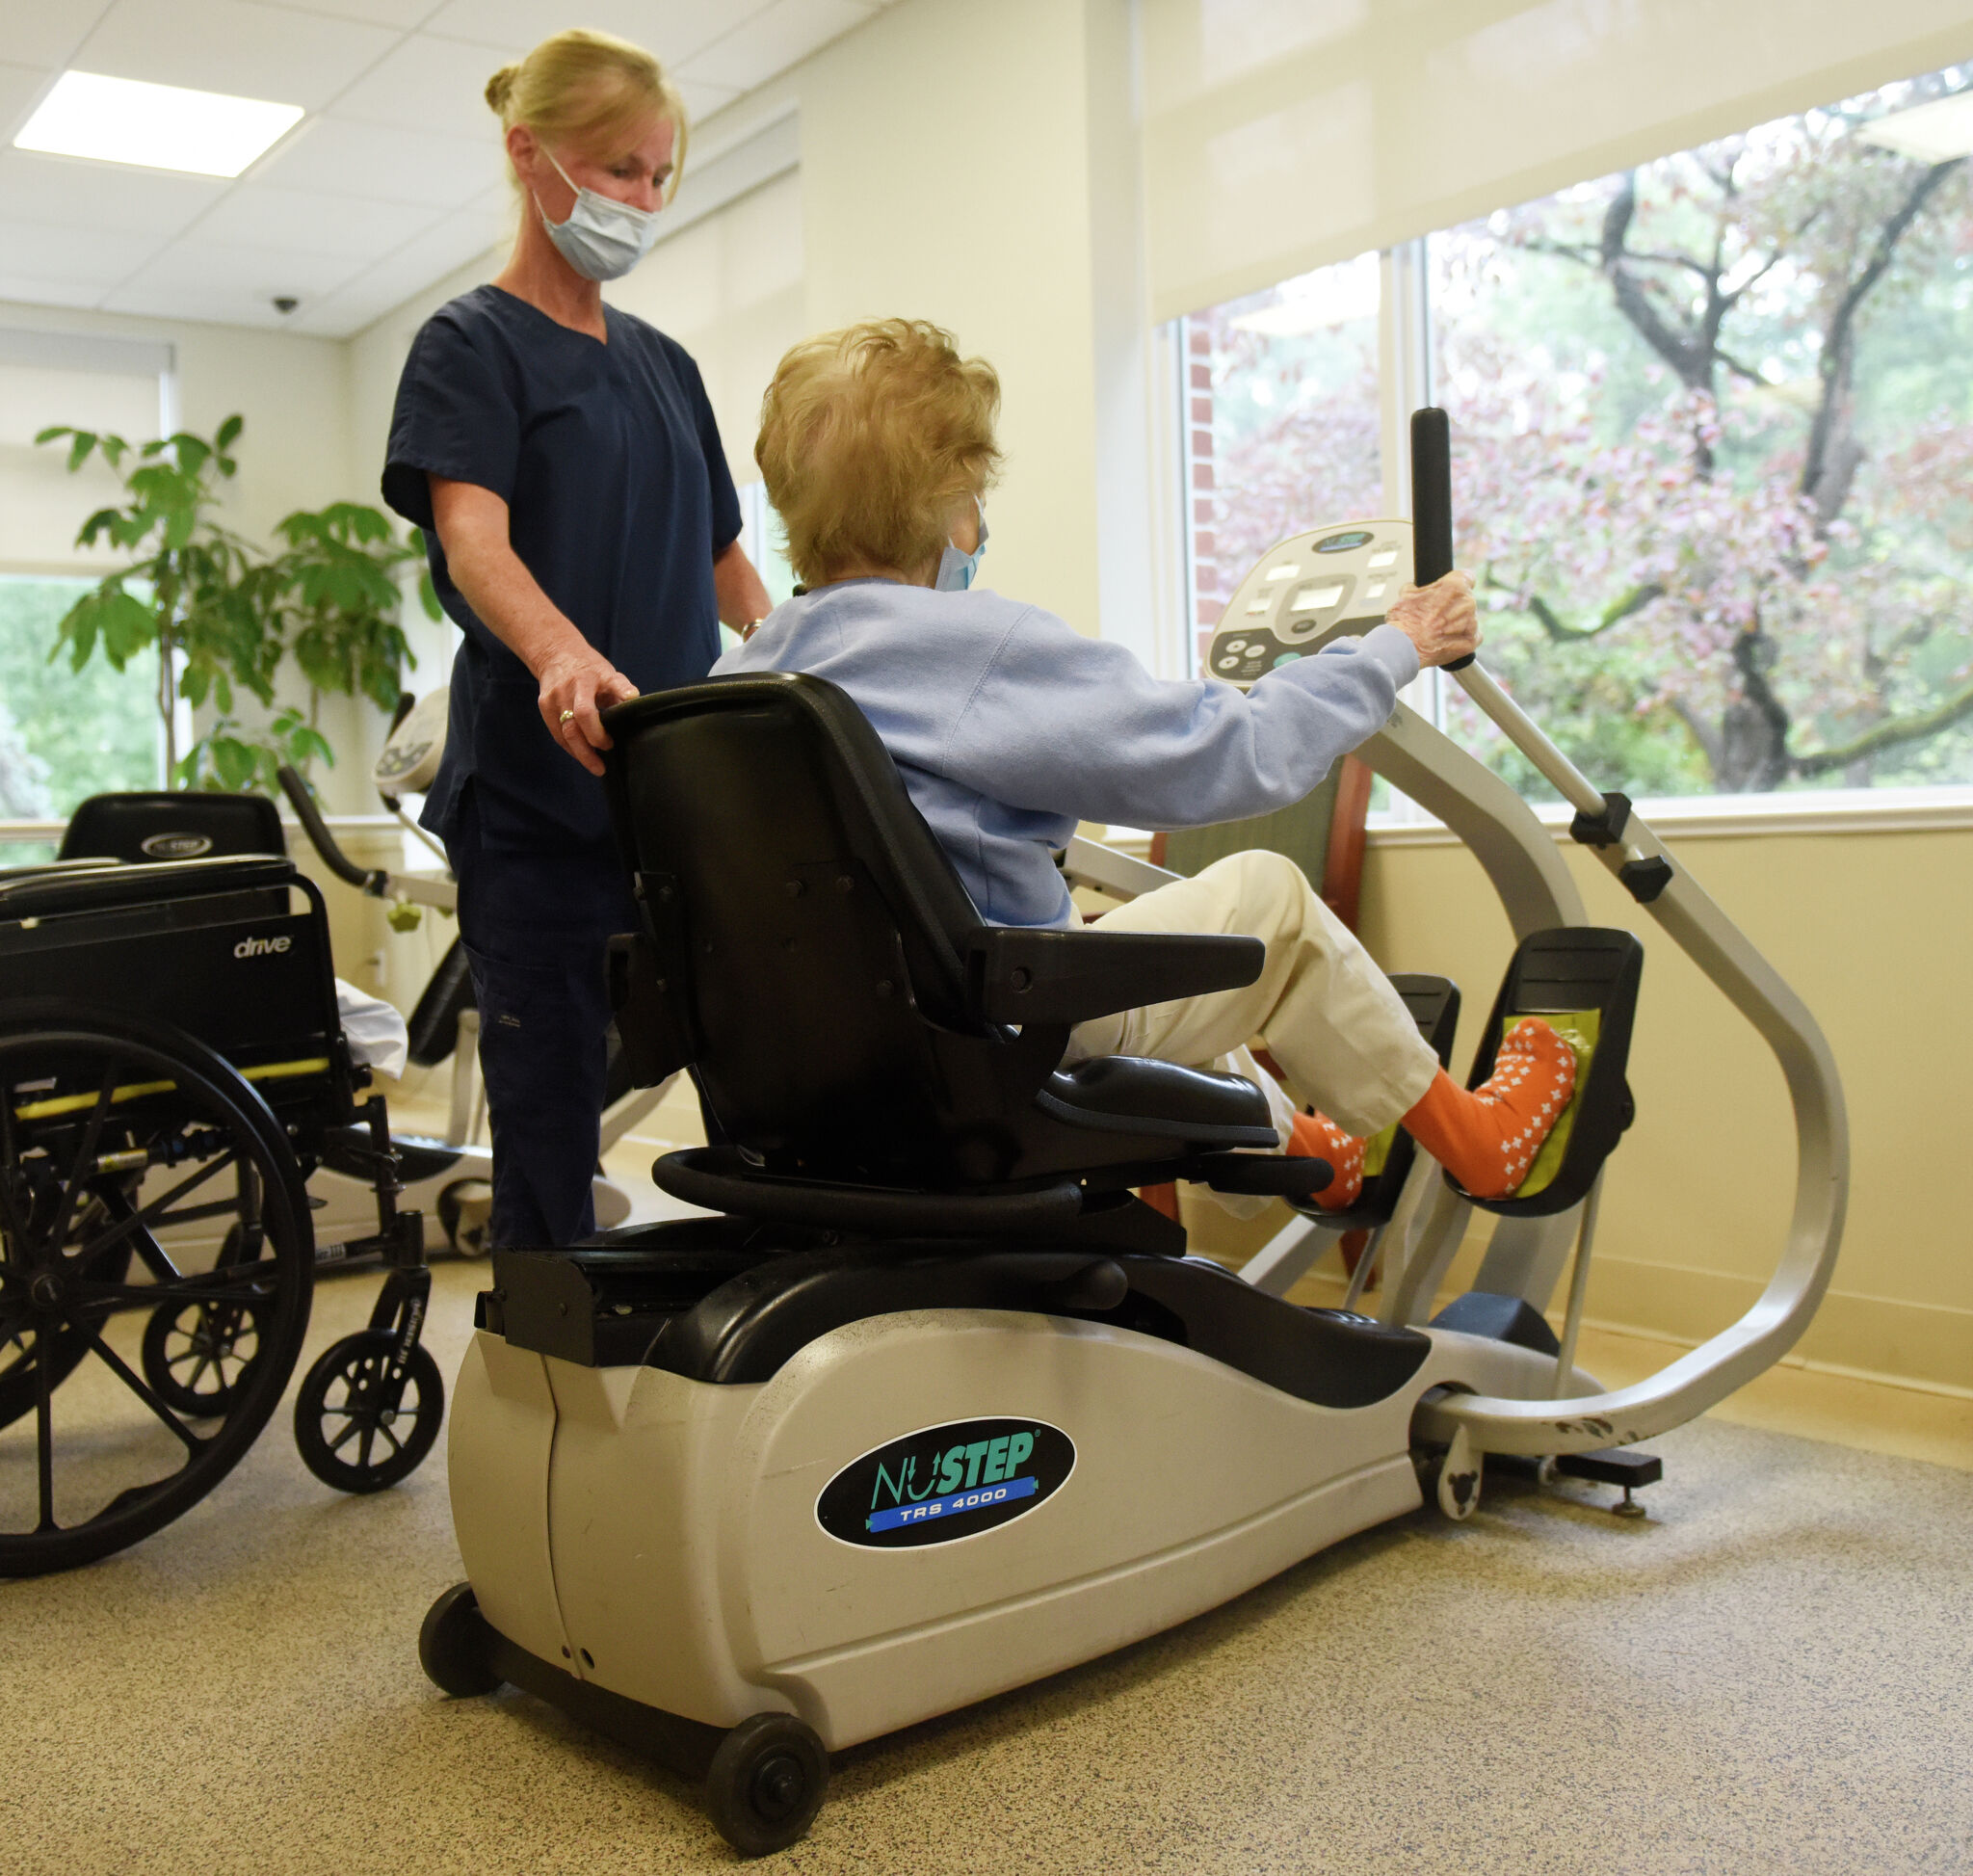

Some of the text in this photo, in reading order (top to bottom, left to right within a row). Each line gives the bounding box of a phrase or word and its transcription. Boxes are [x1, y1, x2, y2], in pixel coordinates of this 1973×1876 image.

[234, 937, 291, 959] drive
[900, 1488, 1008, 1521] TRS 4000
